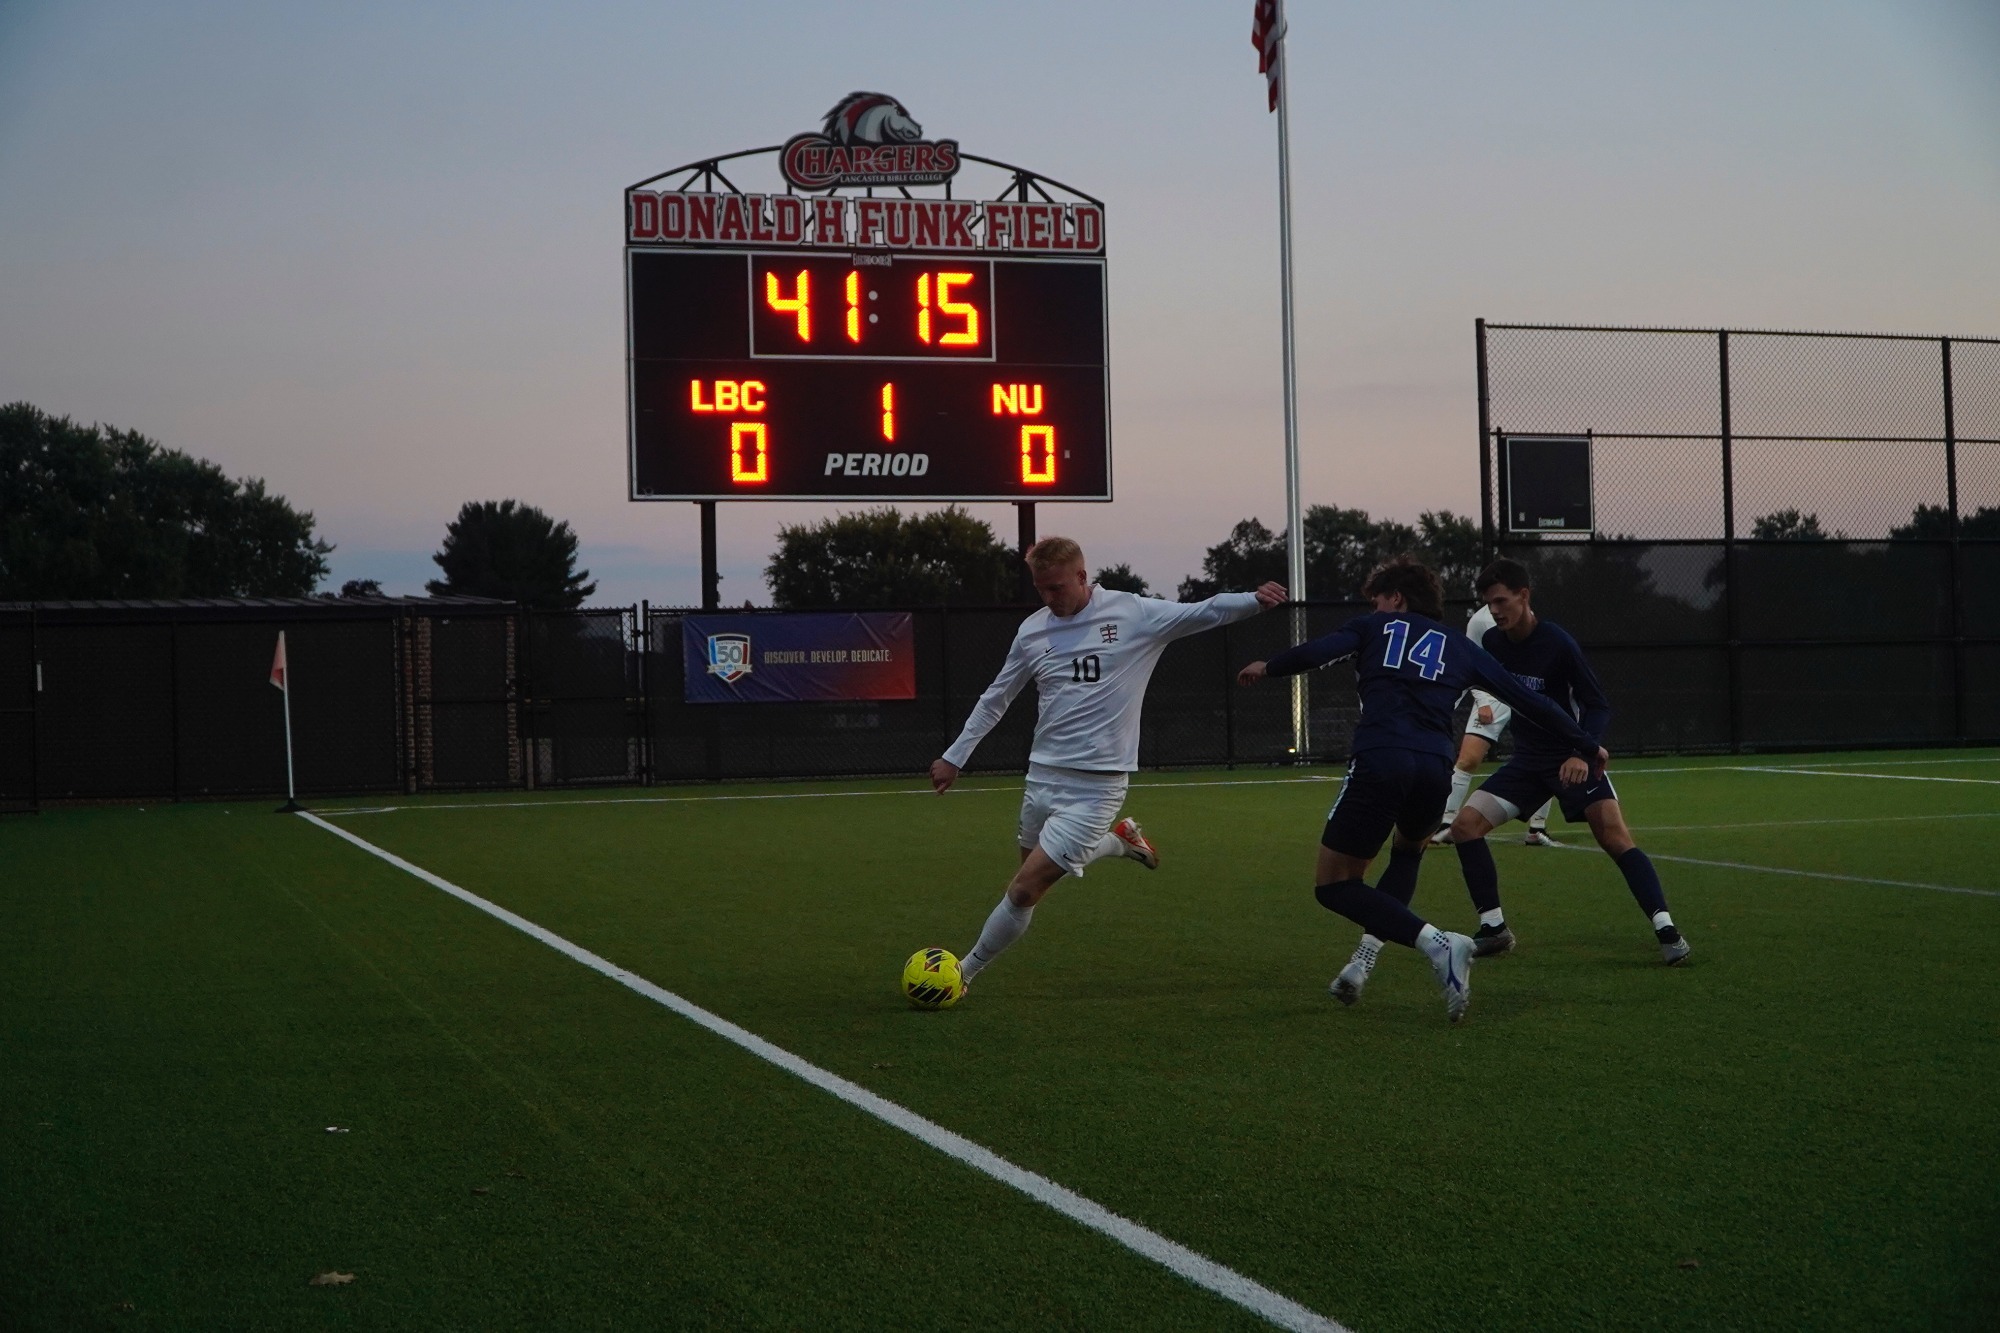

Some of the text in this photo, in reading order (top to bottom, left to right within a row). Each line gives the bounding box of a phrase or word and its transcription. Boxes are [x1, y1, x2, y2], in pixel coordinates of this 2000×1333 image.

[785, 137, 957, 186] CHARGERS
[840, 173, 944, 183] LANCASTER BIBLE COLLEGE
[630, 191, 1104, 250] DONALD H FUNK FIELD
[690, 379, 767, 412] LBC
[881, 382, 894, 442] 1
[992, 383, 1044, 415] NU
[730, 422, 767, 483] 0
[824, 452, 930, 477] PERIOD
[1020, 424, 1056, 484] 0
[717, 645, 743, 664] 50
[764, 649, 893, 664] DISCOVER. DEVELOP. DEDICATE.
[1382, 618, 1448, 682] 14
[1071, 654, 1100, 683] 10
